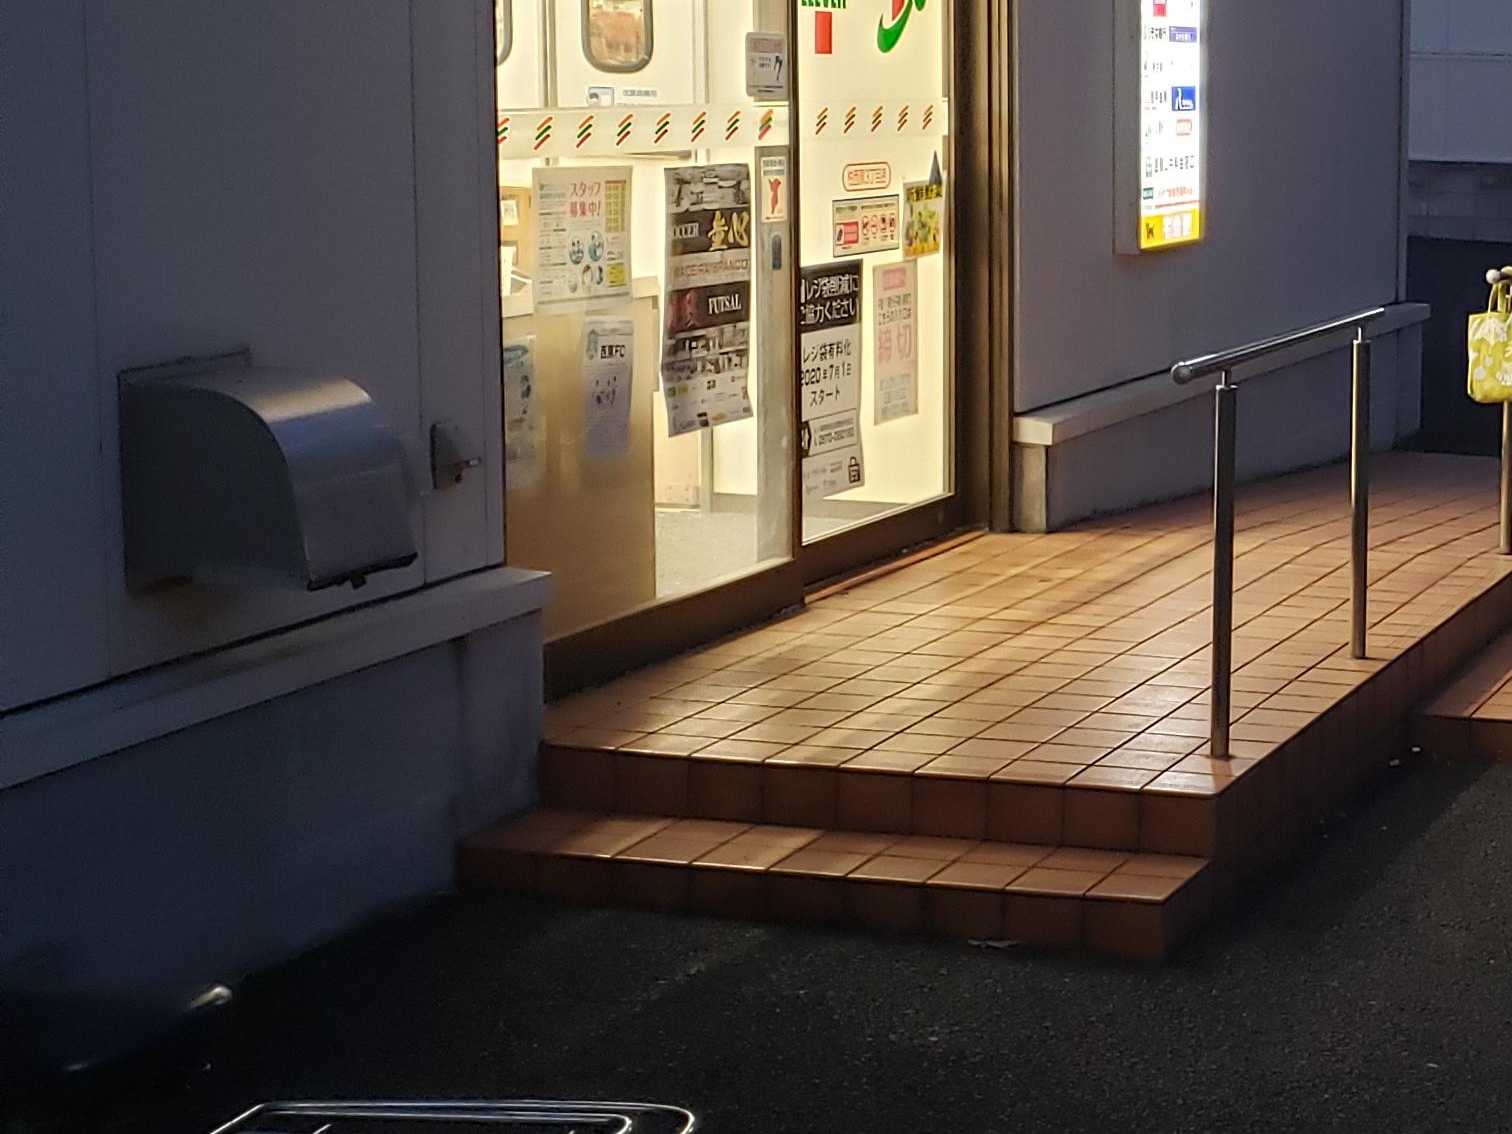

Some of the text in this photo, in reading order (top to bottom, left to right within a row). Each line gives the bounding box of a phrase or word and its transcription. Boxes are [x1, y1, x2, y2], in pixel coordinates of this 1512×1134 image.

[669, 222, 700, 240] OCCER
[708, 293, 742, 315] FUTSAL
[810, 385, 840, 407] スタート
